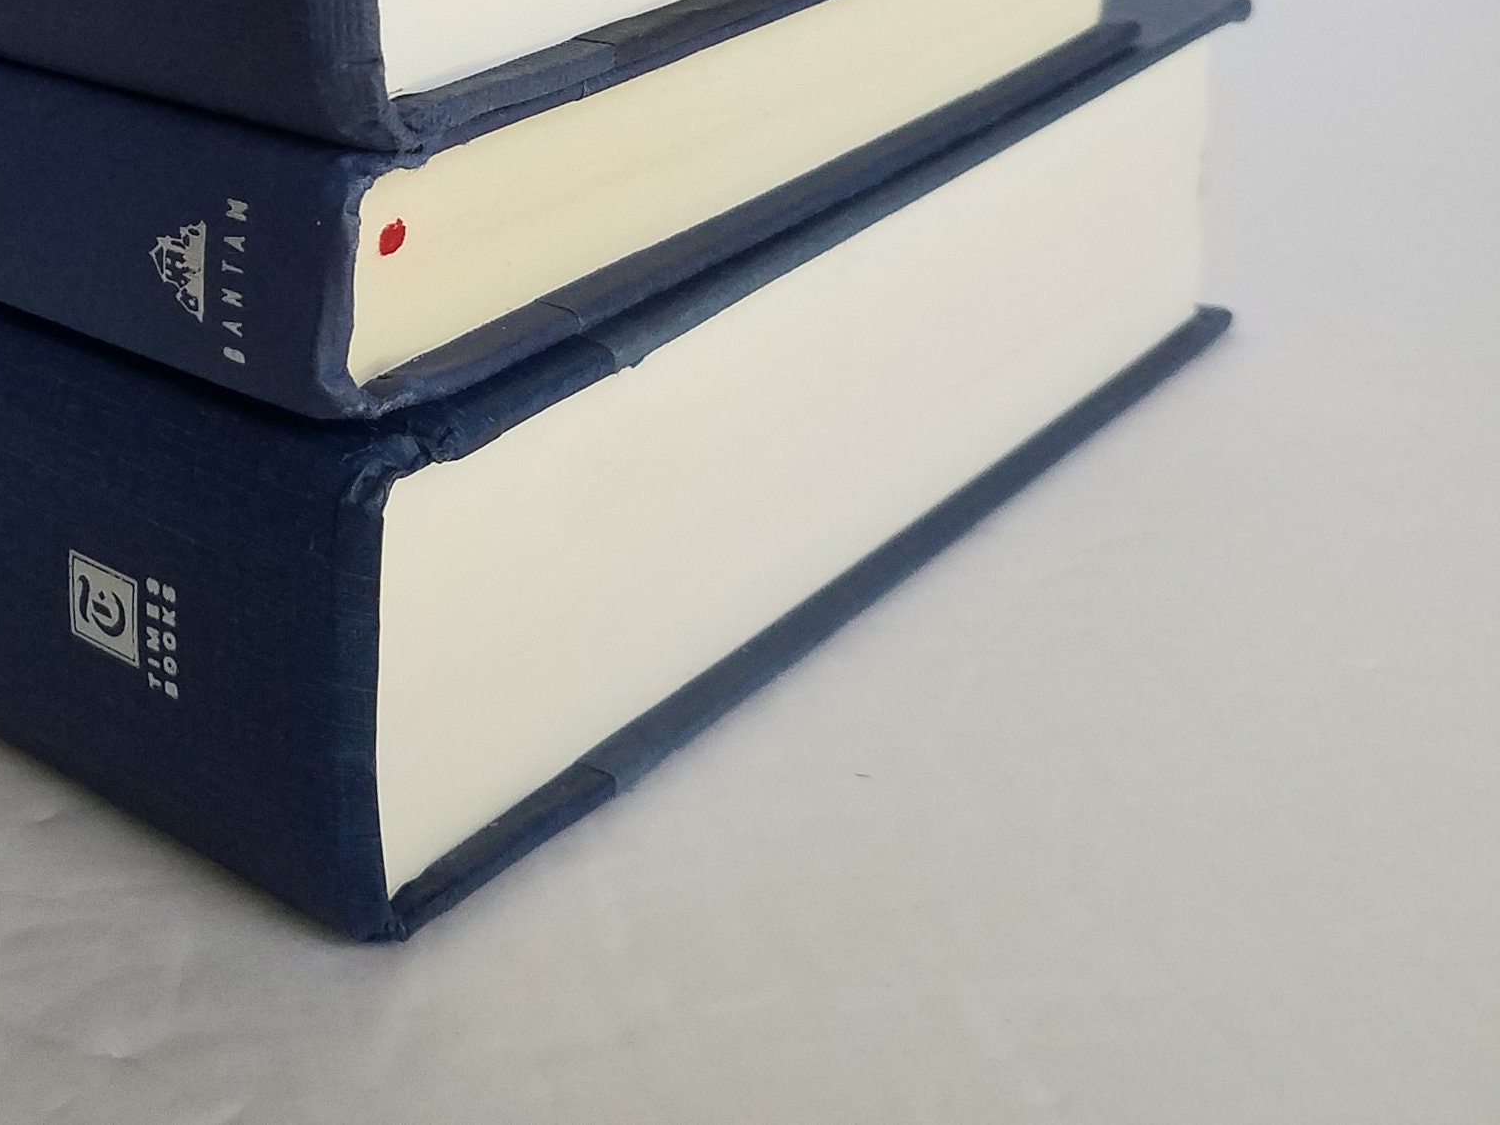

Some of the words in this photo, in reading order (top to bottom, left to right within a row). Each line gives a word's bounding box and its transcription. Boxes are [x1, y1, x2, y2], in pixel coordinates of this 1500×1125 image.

[222, 197, 249, 364] BANTAM
[146, 576, 163, 690] TIMES
[162, 582, 179, 700] BOOKS
